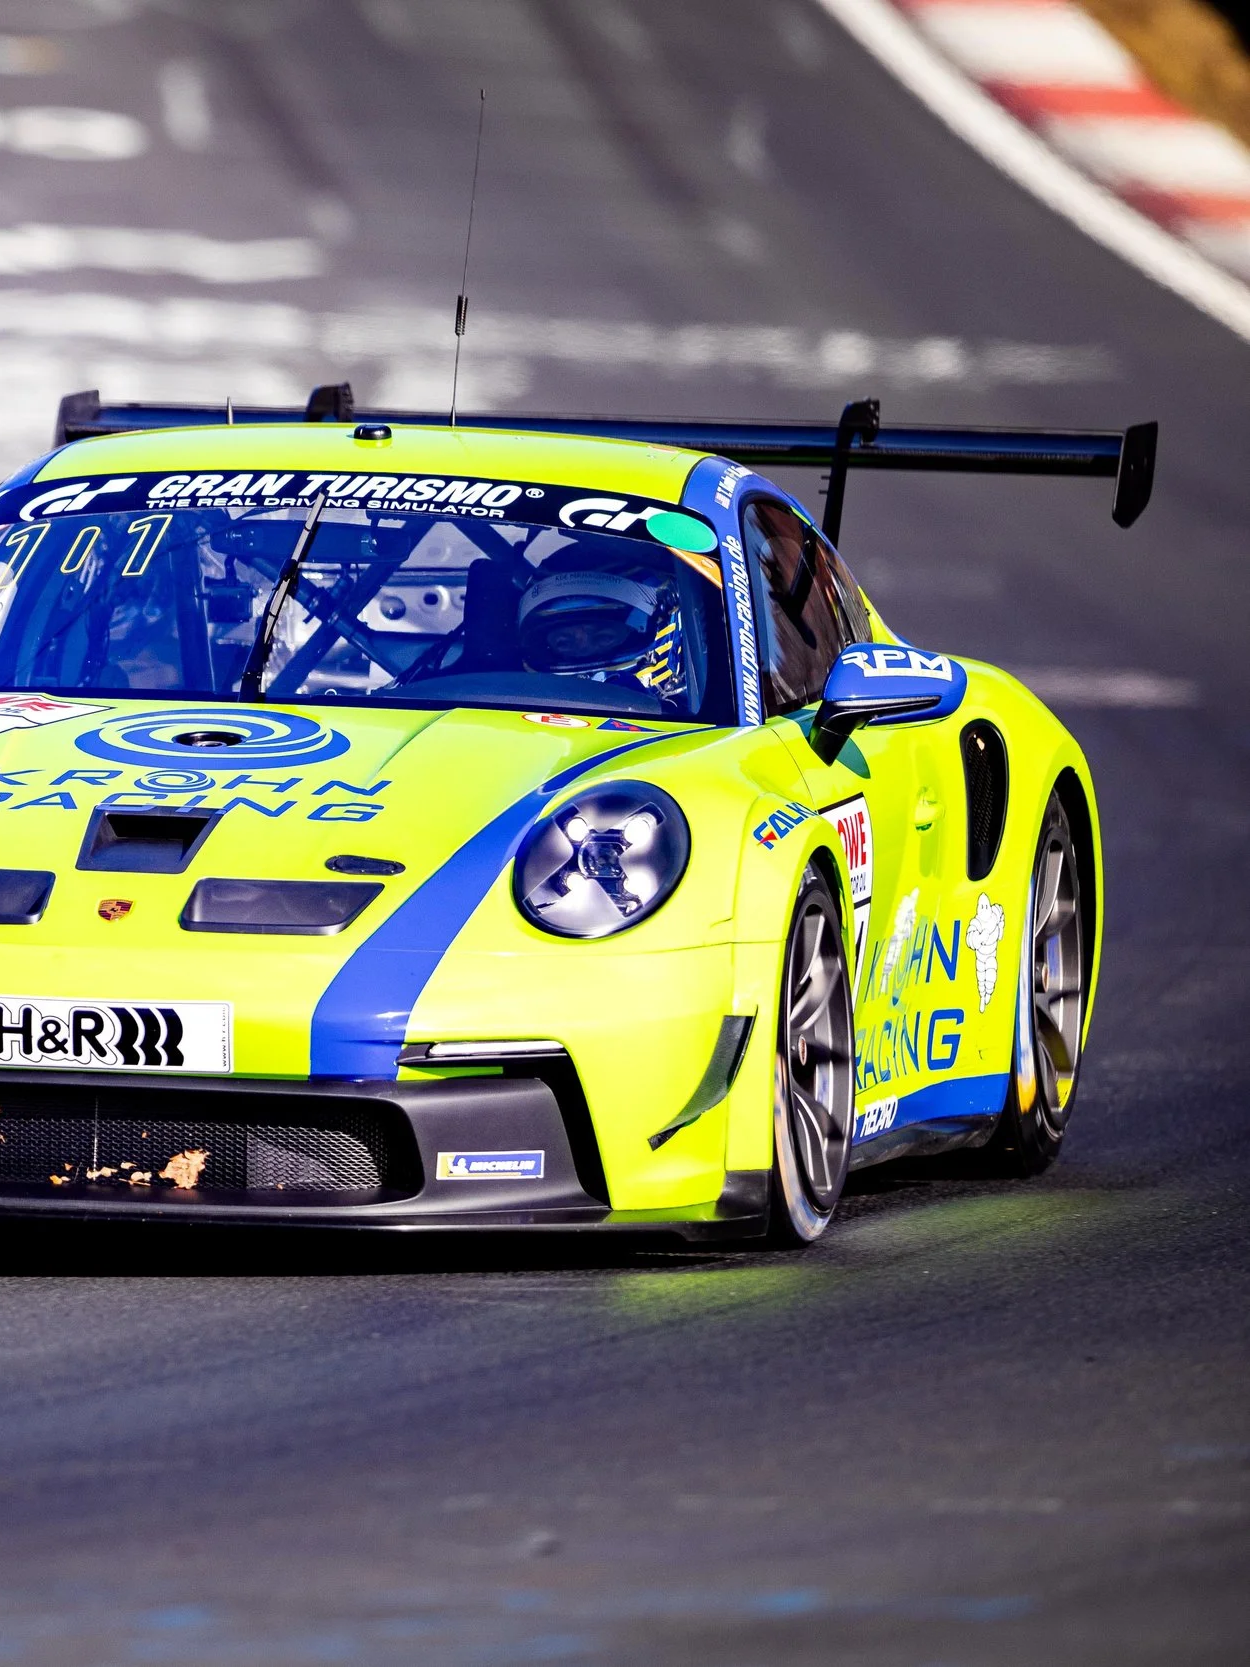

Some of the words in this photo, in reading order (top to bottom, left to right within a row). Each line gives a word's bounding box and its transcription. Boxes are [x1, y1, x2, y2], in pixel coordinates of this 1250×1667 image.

[148, 474, 294, 498] GRAN
[146, 498, 185, 508] THE
[203, 498, 262, 507] REAL
[263, 498, 360, 508] DRIVNG
[366, 499, 506, 519] SIMULATOR
[841, 650, 953, 682] RPM
[837, 811, 867, 871] OWE
